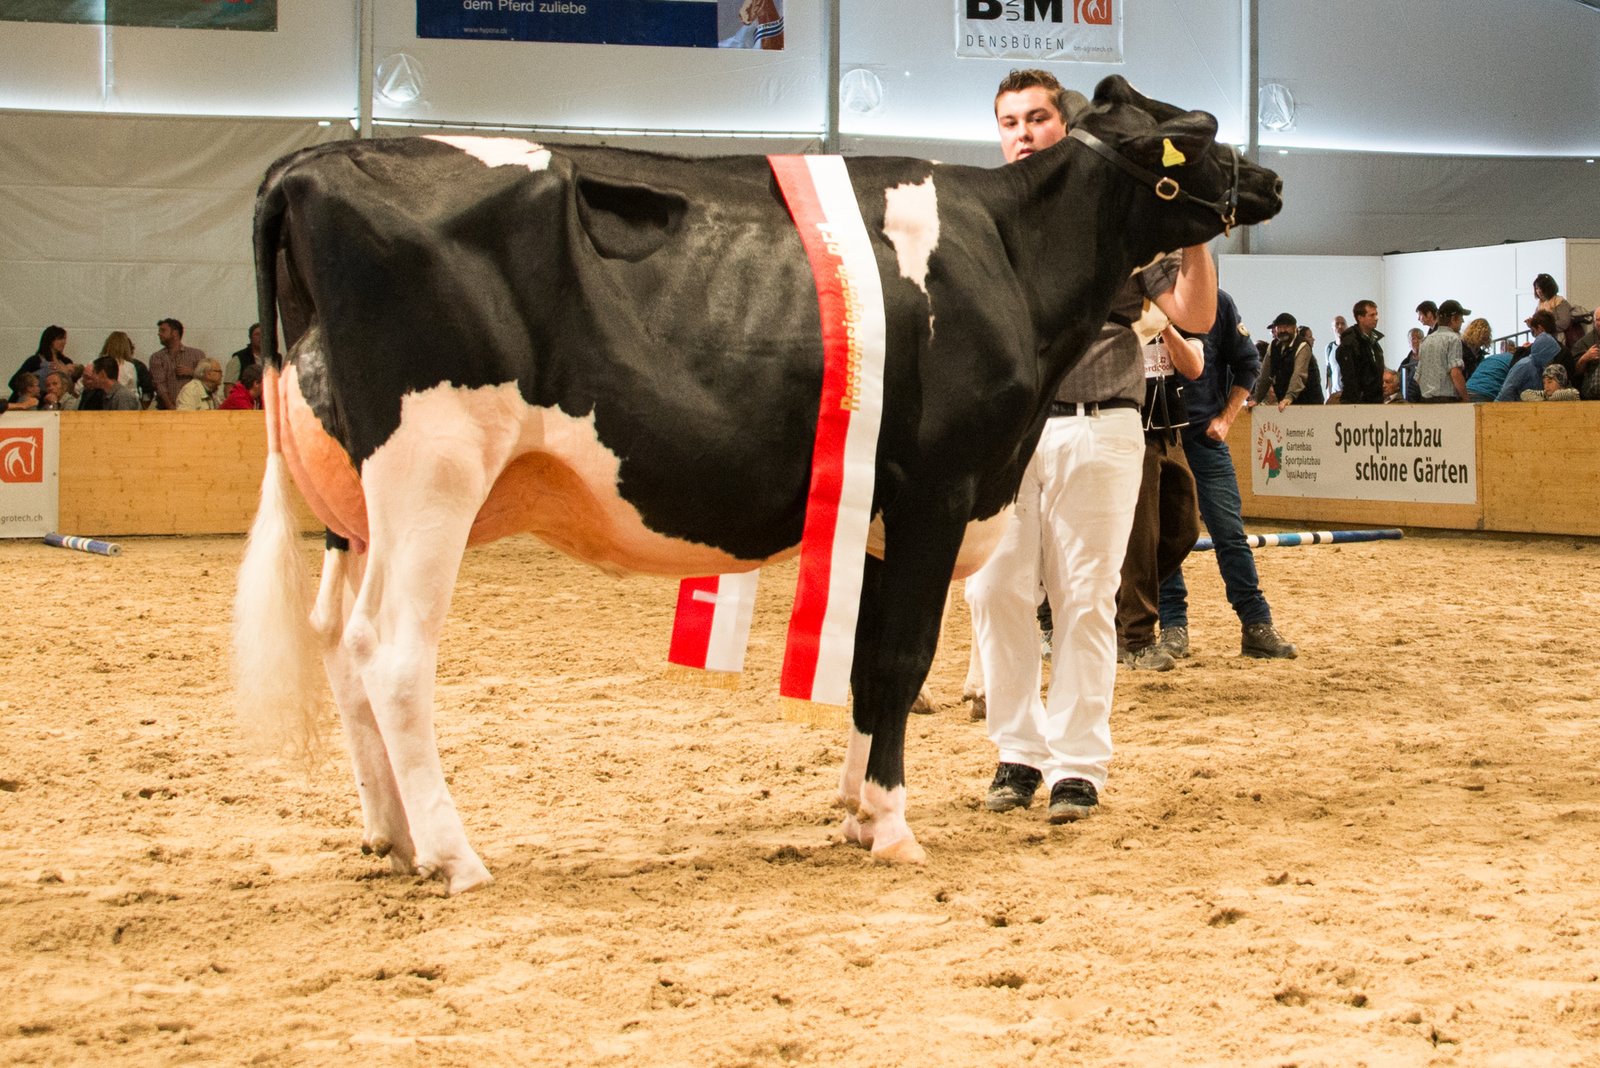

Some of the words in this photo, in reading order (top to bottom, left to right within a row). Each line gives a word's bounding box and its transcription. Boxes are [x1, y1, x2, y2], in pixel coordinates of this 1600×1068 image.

[463, 0, 493, 10] dem
[498, 0, 535, 12] Pferd
[539, 1, 587, 14] zuliebe
[966, 34, 1065, 50] DENSBÜREN
[1307, 428, 1314, 437] AG
[1335, 420, 1442, 453] Sportplatzbau
[1286, 442, 1312, 451] Gartenbau
[1285, 455, 1321, 467] Sportplatzbau
[1355, 455, 1408, 482] schöne
[1413, 456, 1468, 484] Gärten
